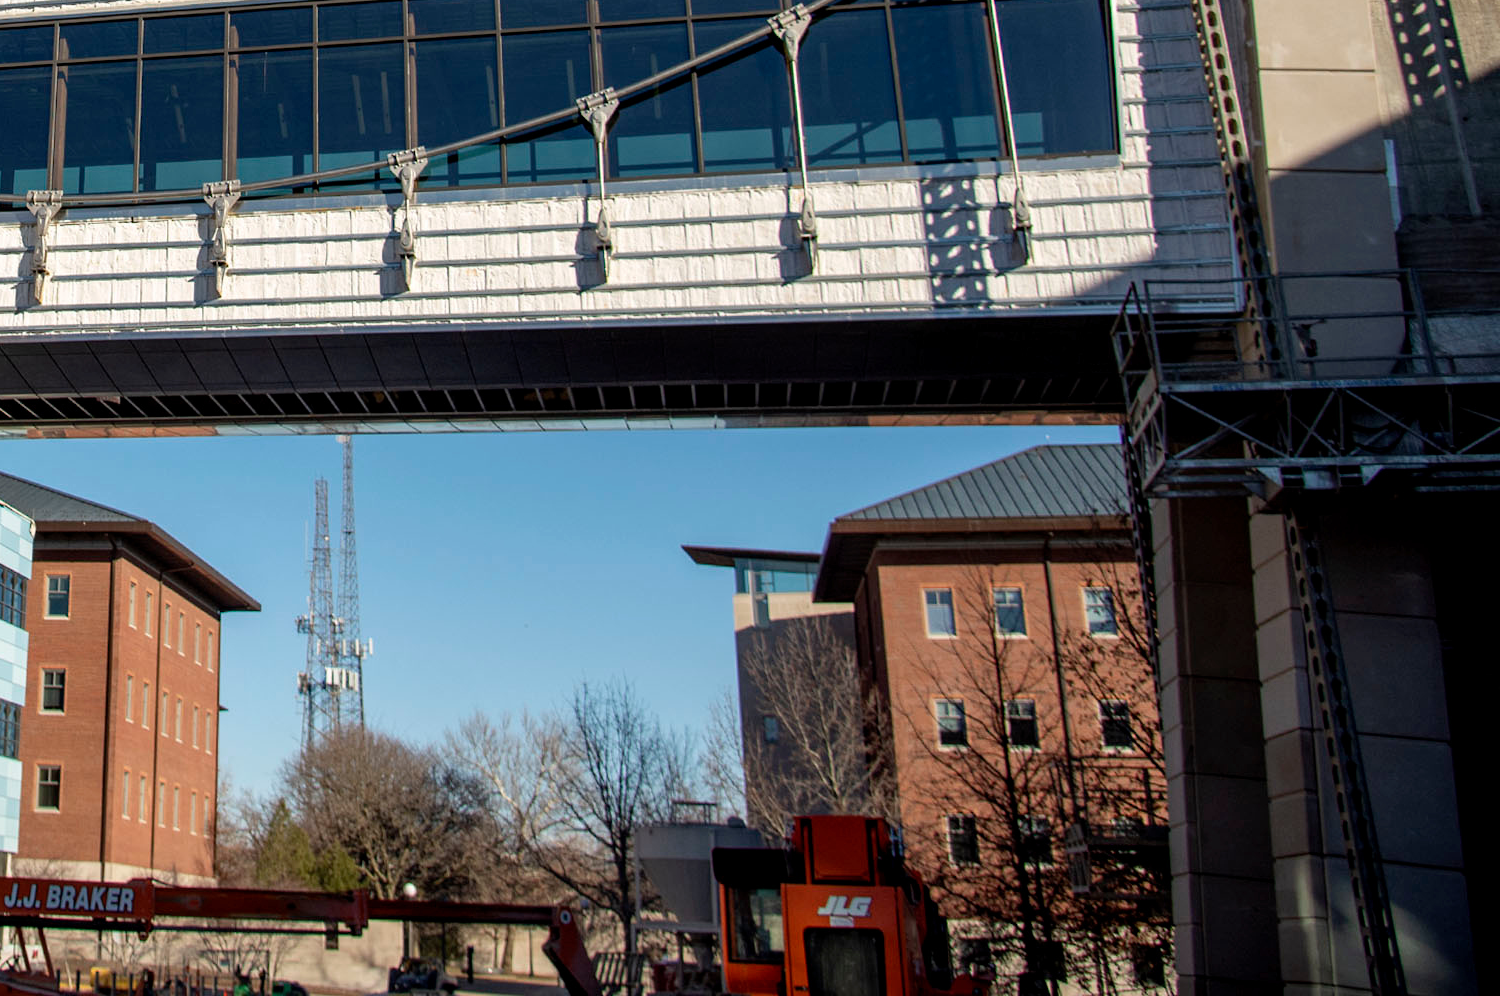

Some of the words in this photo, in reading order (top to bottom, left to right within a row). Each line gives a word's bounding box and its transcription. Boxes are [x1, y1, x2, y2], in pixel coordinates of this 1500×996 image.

[4, 883, 41, 909] J.J.
[46, 884, 134, 912] BRAKER
[817, 895, 872, 916] JLG
